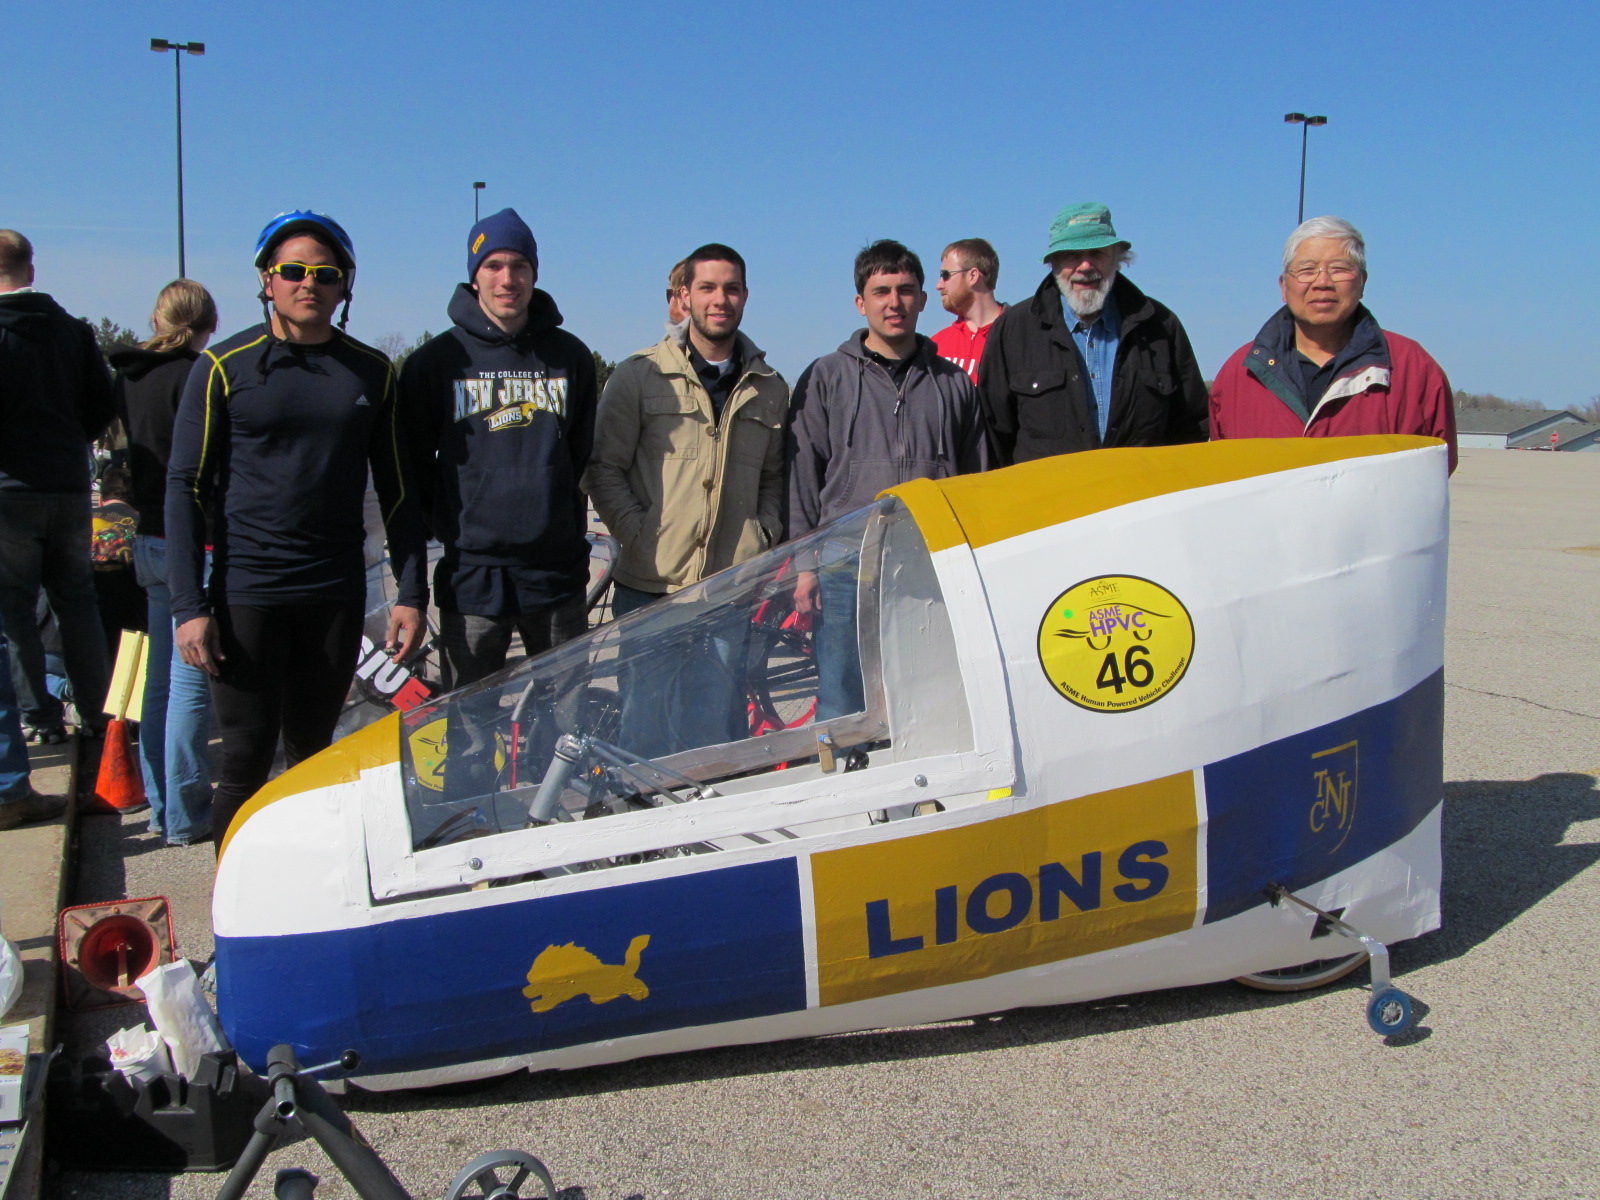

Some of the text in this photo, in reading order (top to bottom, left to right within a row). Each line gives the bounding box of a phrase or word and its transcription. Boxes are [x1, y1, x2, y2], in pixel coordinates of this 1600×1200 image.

[479, 371, 496, 379] THE
[497, 370, 532, 379] COLLEGE
[453, 377, 568, 423] NEW JERSEY
[489, 410, 522, 429] LIONS
[1090, 582, 1120, 597] ASME
[1089, 605, 1122, 622] ASME
[1090, 611, 1147, 638] HPVC
[1060, 656, 1186, 708] ASME Human Powered Vehicle Challenge
[1096, 644, 1155, 695] 46
[865, 840, 1170, 960] LIONS
